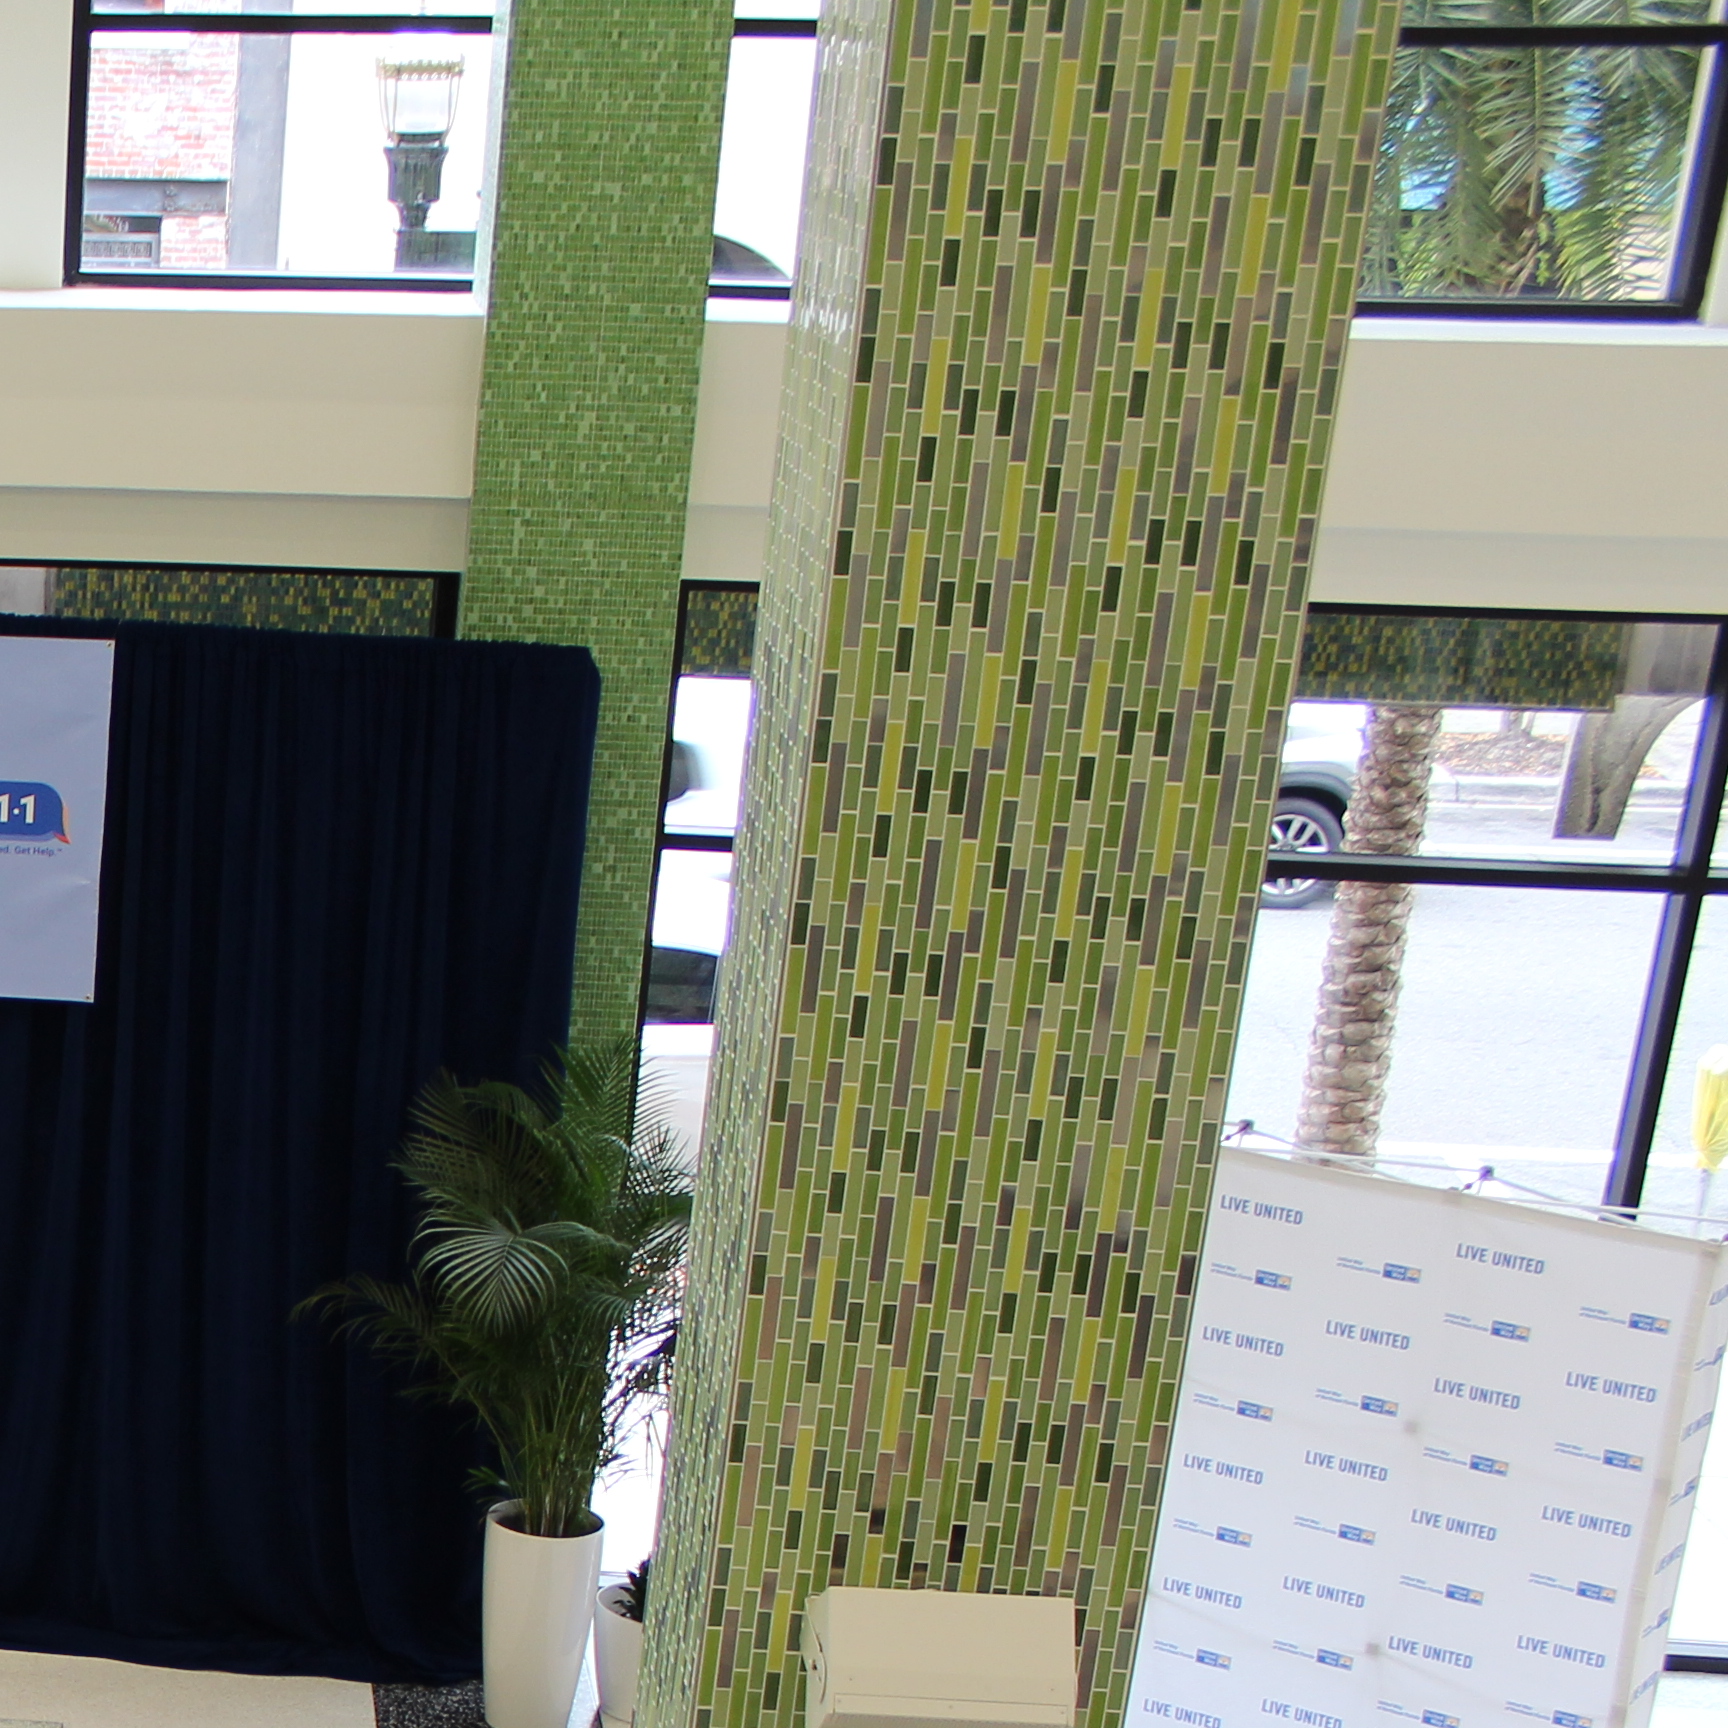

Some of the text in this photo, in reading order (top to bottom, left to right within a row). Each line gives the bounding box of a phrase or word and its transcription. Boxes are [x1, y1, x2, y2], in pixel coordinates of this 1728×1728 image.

[14, 845, 32, 855] Get
[1220, 1194, 1303, 1225] LIVE UNITED
[1456, 1243, 1545, 1275] LIVE UNITED
[1202, 1326, 1284, 1357] LIVE UNITED
[1325, 1320, 1410, 1350] LIVE UNITED
[1433, 1377, 1521, 1410] LIVE UNITED
[1565, 1371, 1657, 1403] LIVE UNITED
[1183, 1453, 1263, 1485] LIVE UNITED
[1305, 1450, 1388, 1482] LIVE UNITED
[1410, 1508, 1497, 1541] LIVE UNITED
[1542, 1505, 1632, 1538] LIVE UNITED
[1163, 1577, 1242, 1609] LIVE UNITED
[1283, 1575, 1365, 1608] LIVE UNITED
[1388, 1636, 1473, 1669] LIVE UNITED
[1517, 1635, 1606, 1668] LIVE UNITED
[1143, 1698, 1172, 1718] LIVE
[1261, 1699, 1291, 1719] LIVE
